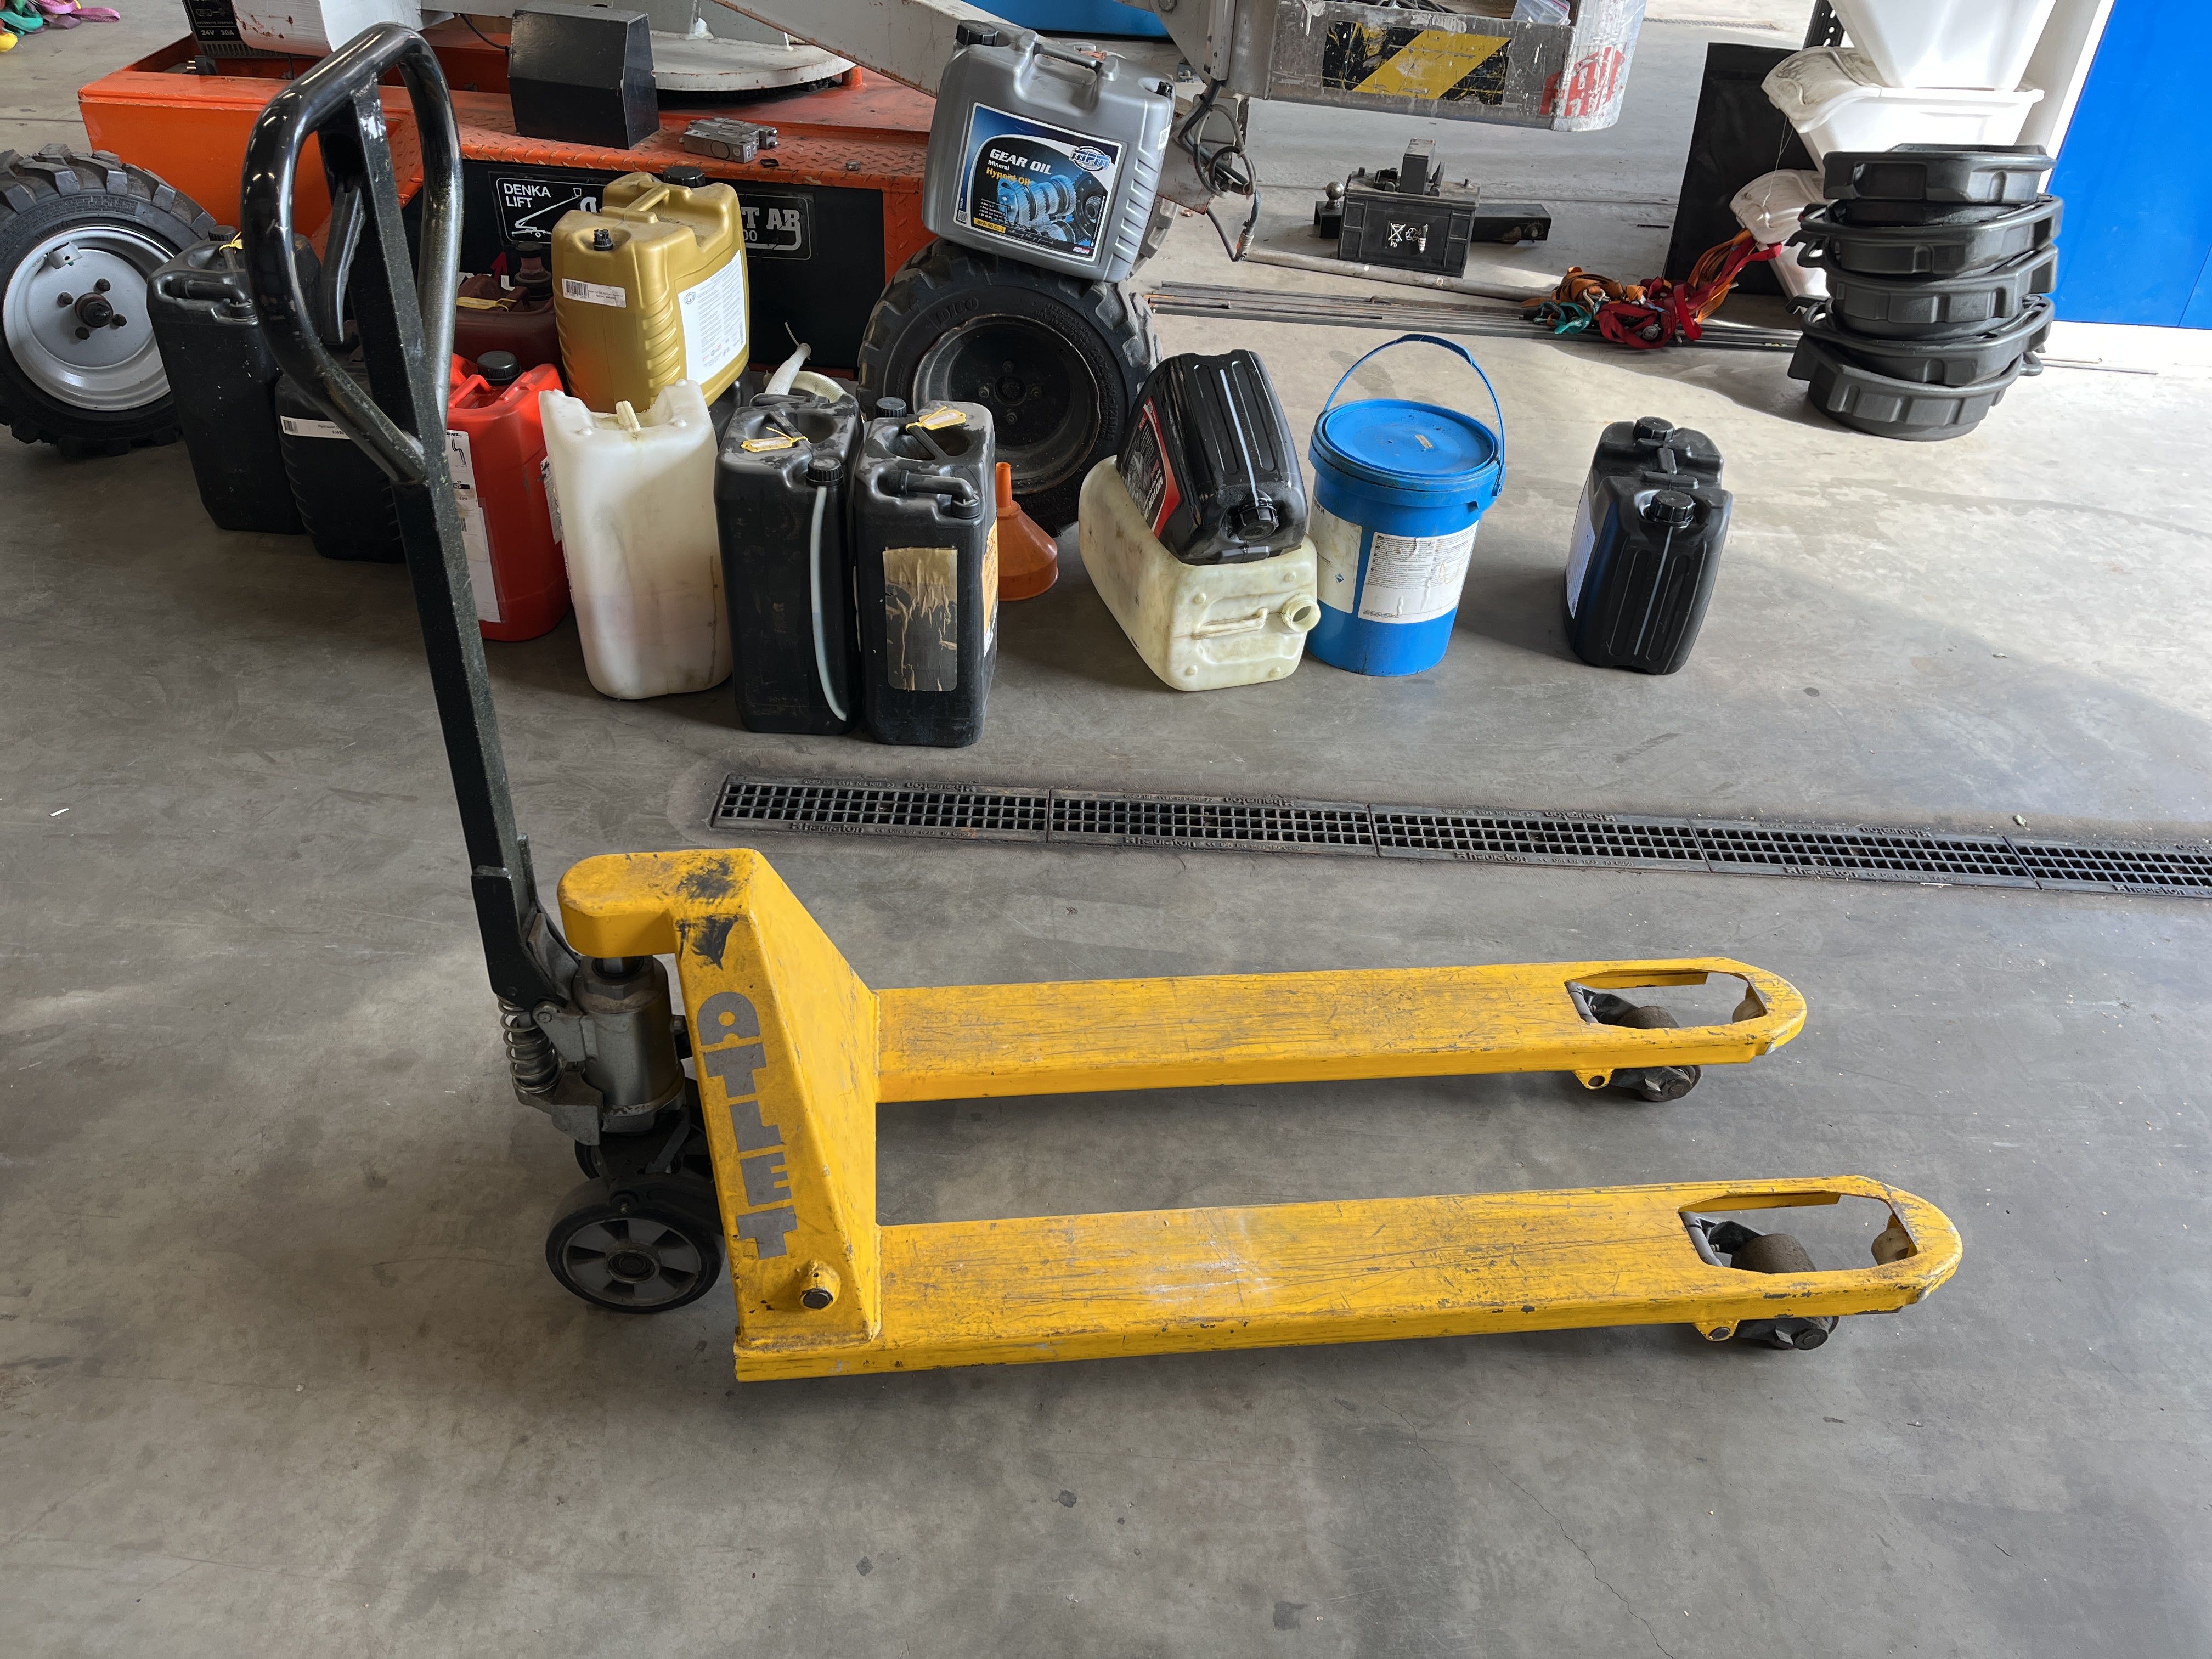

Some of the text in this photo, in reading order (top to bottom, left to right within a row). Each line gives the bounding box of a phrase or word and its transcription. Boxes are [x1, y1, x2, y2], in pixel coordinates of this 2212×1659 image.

[988, 160, 1009, 171] Mineral
[989, 149, 1052, 175] GEAR OIL
[986, 167, 1031, 186] Hypoid Oil
[503, 183, 551, 197] DENKA
[506, 196, 532, 208] LIFT
[766, 208, 801, 232] AB
[977, 220, 994, 228] 80W-90
[1466, 851, 1528, 862] hauraton
[1799, 867, 1858, 878] hauraton
[2124, 884, 2186, 895] hauraton
[698, 991, 798, 1260] ATLET
